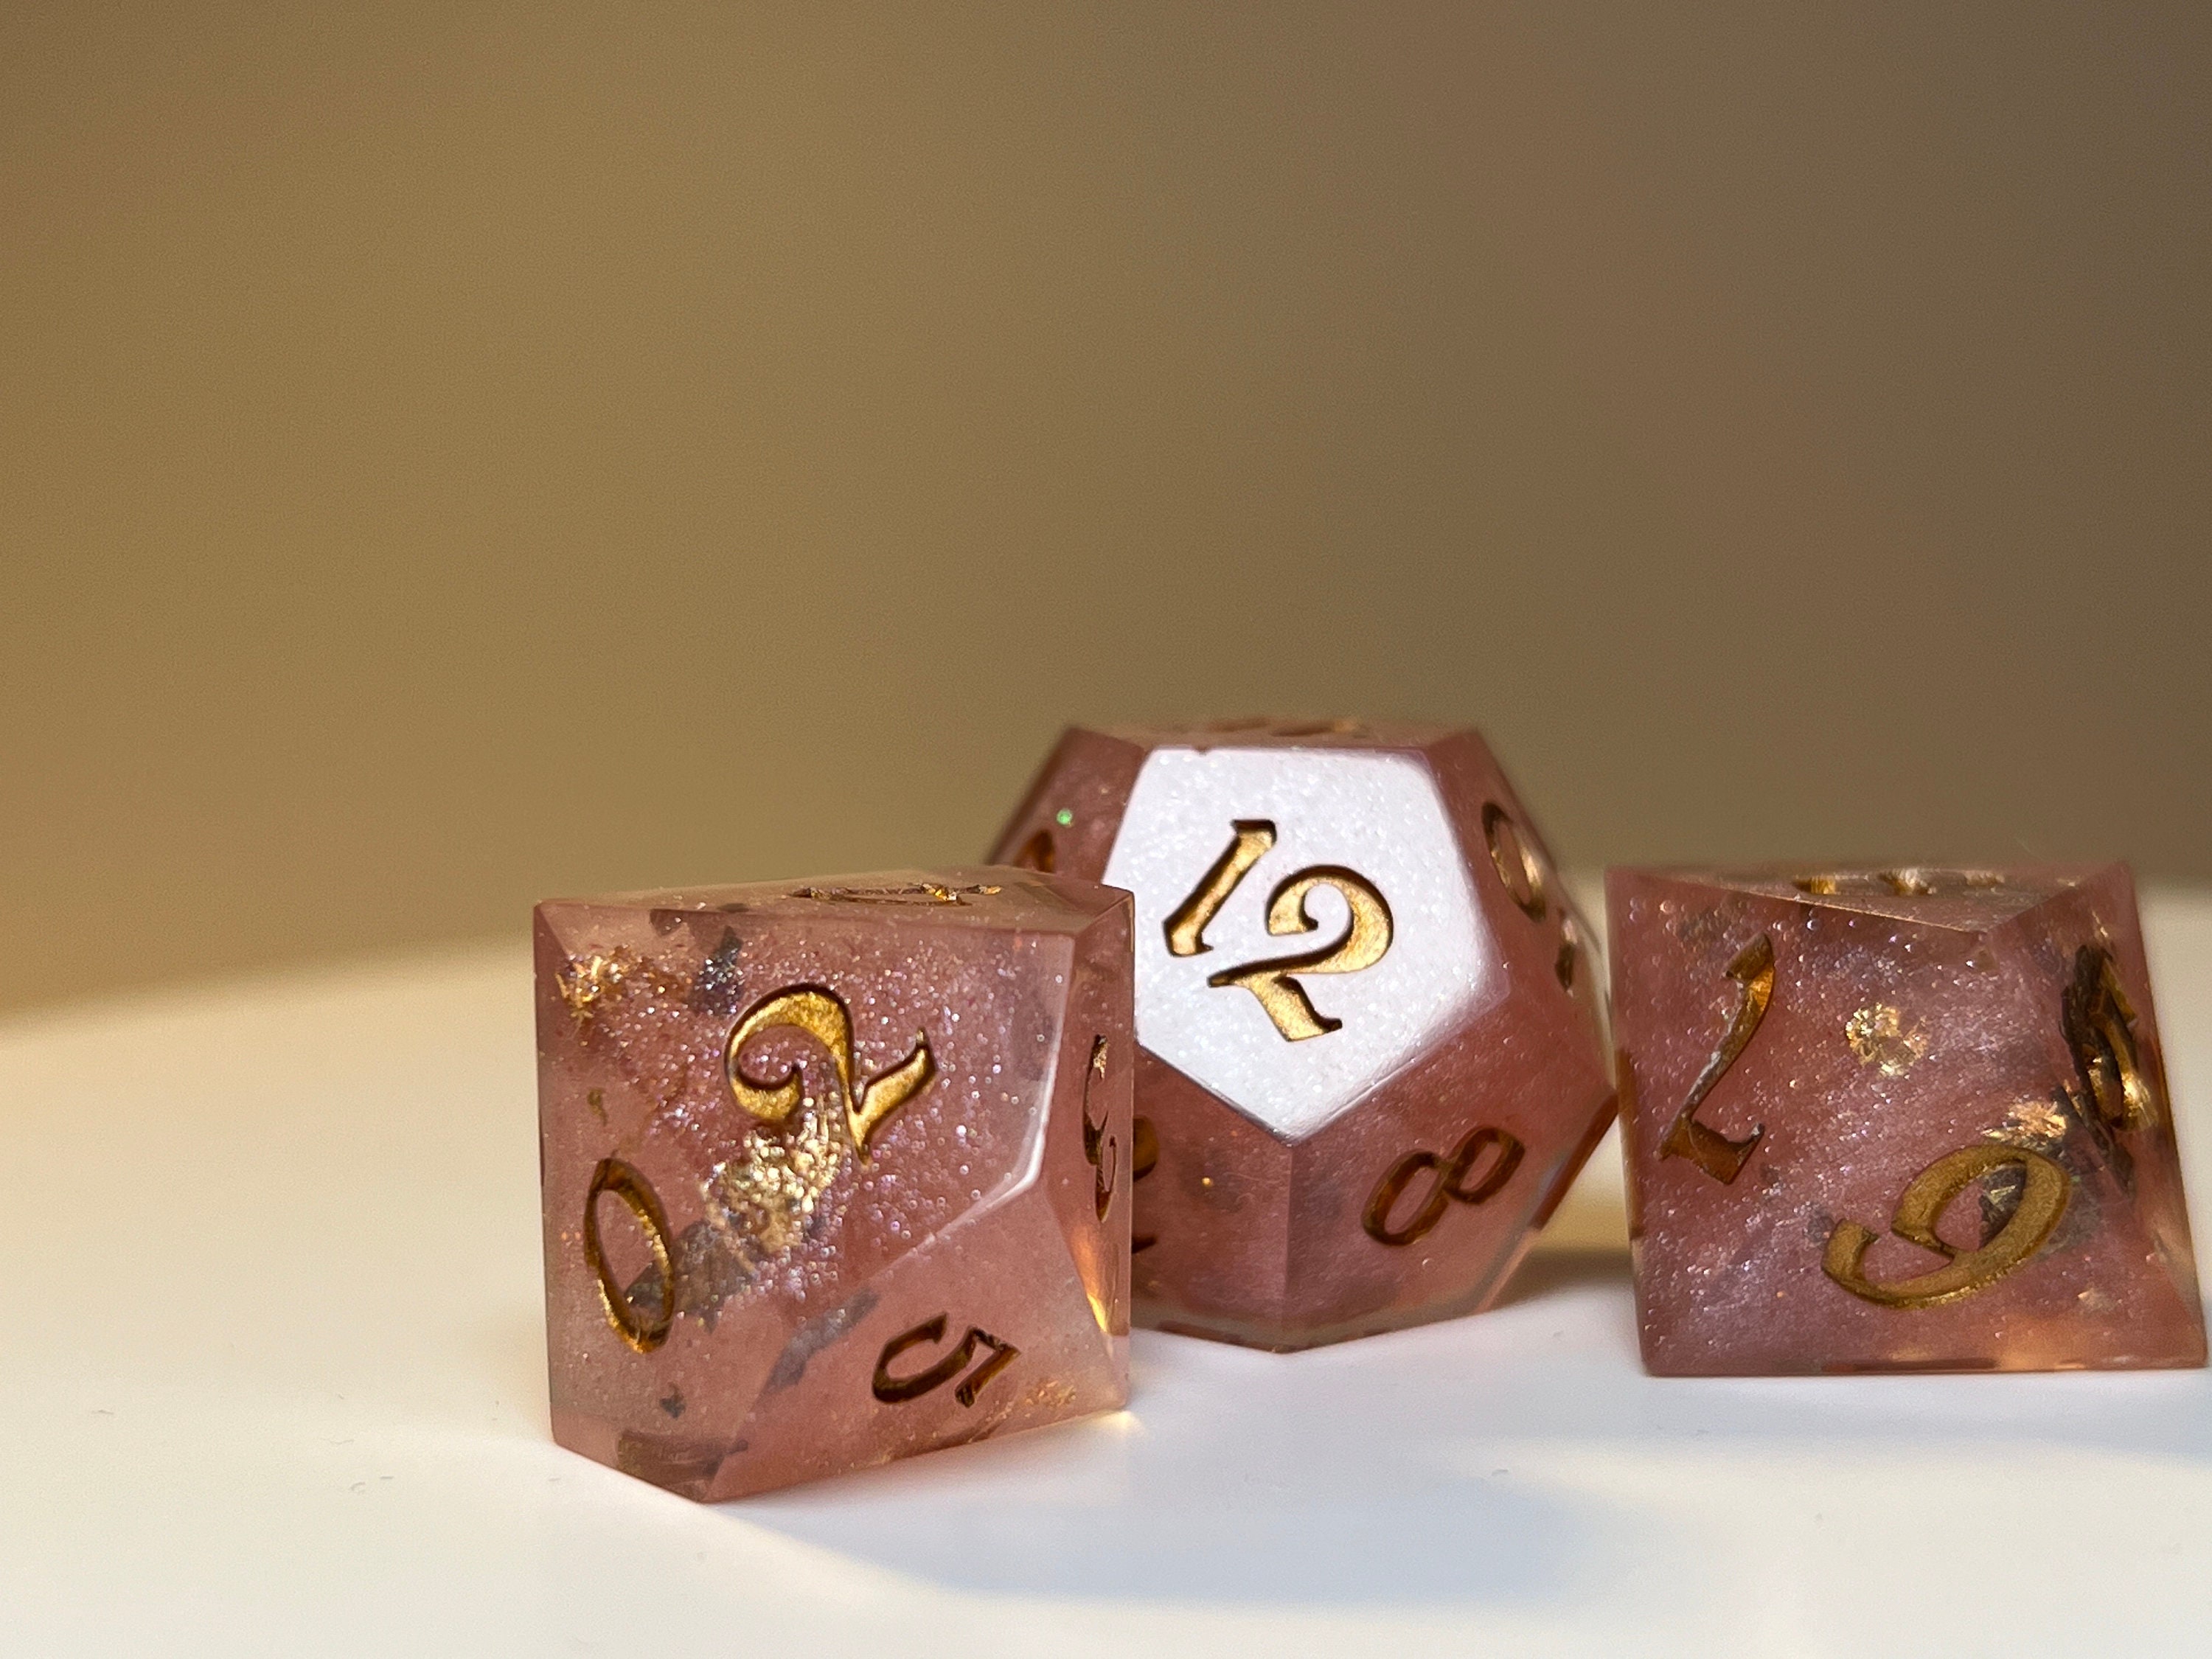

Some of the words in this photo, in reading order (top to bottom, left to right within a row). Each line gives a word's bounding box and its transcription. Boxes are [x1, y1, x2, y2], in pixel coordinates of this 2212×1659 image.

[1163, 818, 1394, 1043] 12
[723, 983, 937, 1166] 2
[583, 1158, 675, 1354] 0
[1361, 1127, 1526, 1247] 8
[872, 1312, 1021, 1408] 5
